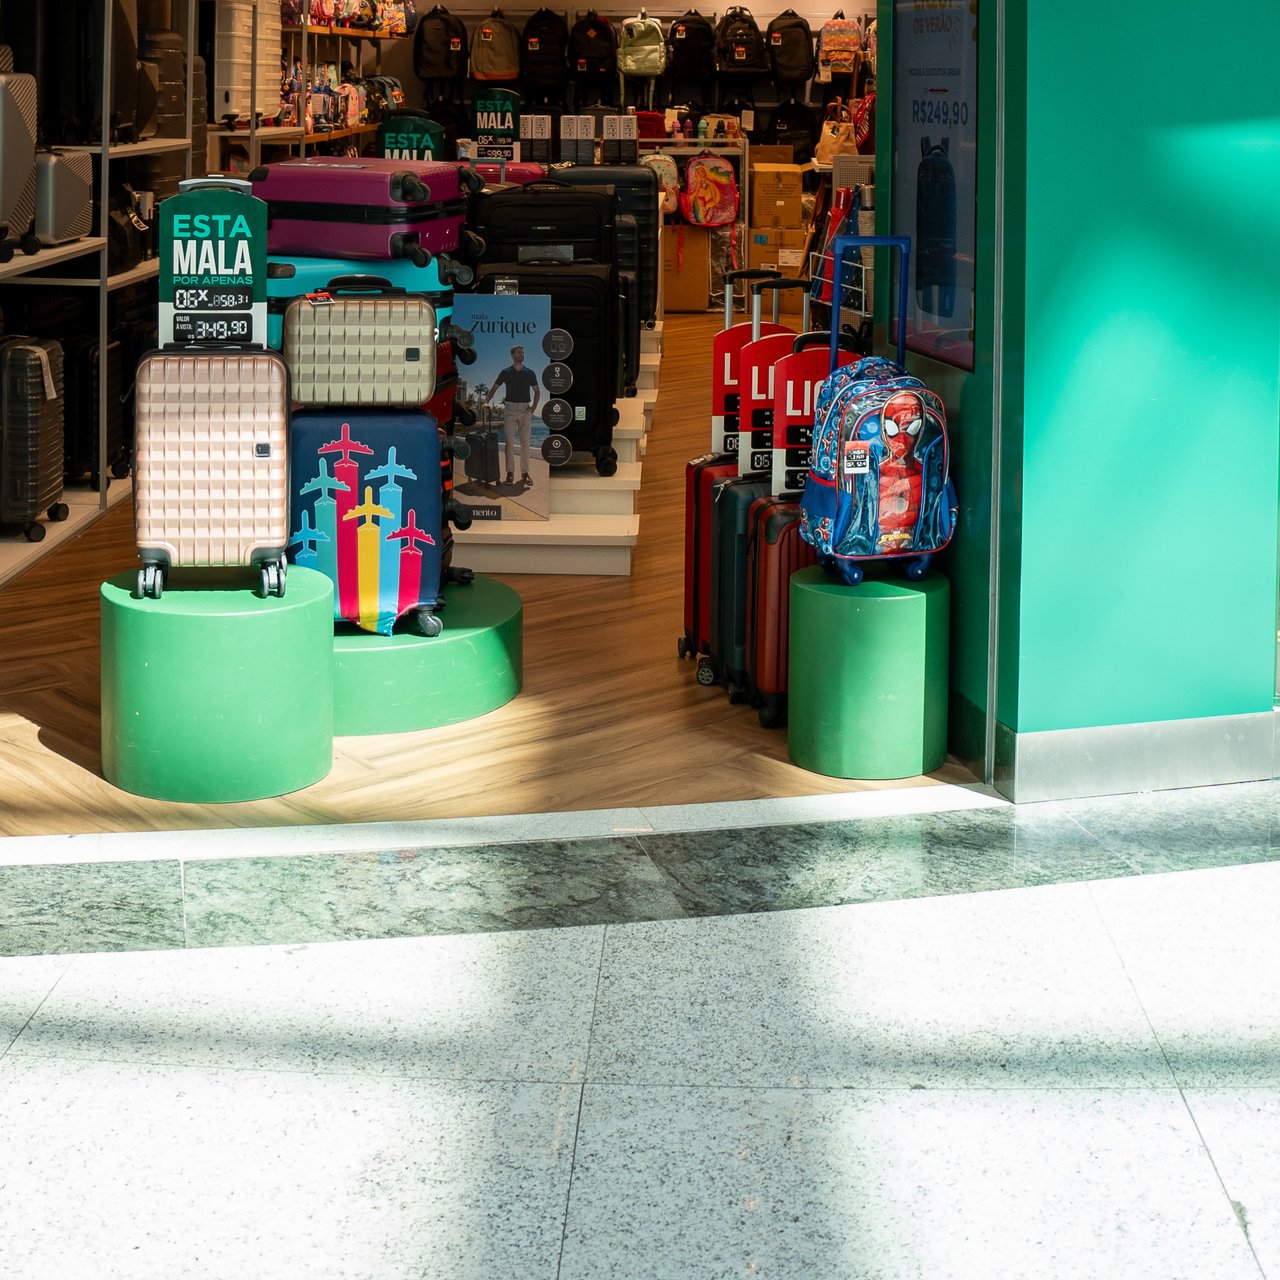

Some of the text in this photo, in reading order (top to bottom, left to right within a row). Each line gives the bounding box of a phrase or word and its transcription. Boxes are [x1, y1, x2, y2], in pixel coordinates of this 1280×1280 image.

[913, 13, 952, 34] DE VERÃO
[477, 100, 513, 112] ESTA
[912, 100, 969, 130] R$249,90
[477, 112, 514, 129] MALA
[384, 133, 434, 149] ESTA
[173, 215, 253, 238] ESTA
[173, 240, 253, 275] MALA
[173, 276, 253, 285] POR APENAS
[196, 321, 247, 339] 349,90
[470, 316, 536, 338] zurique
[472, 509, 497, 517] mento
